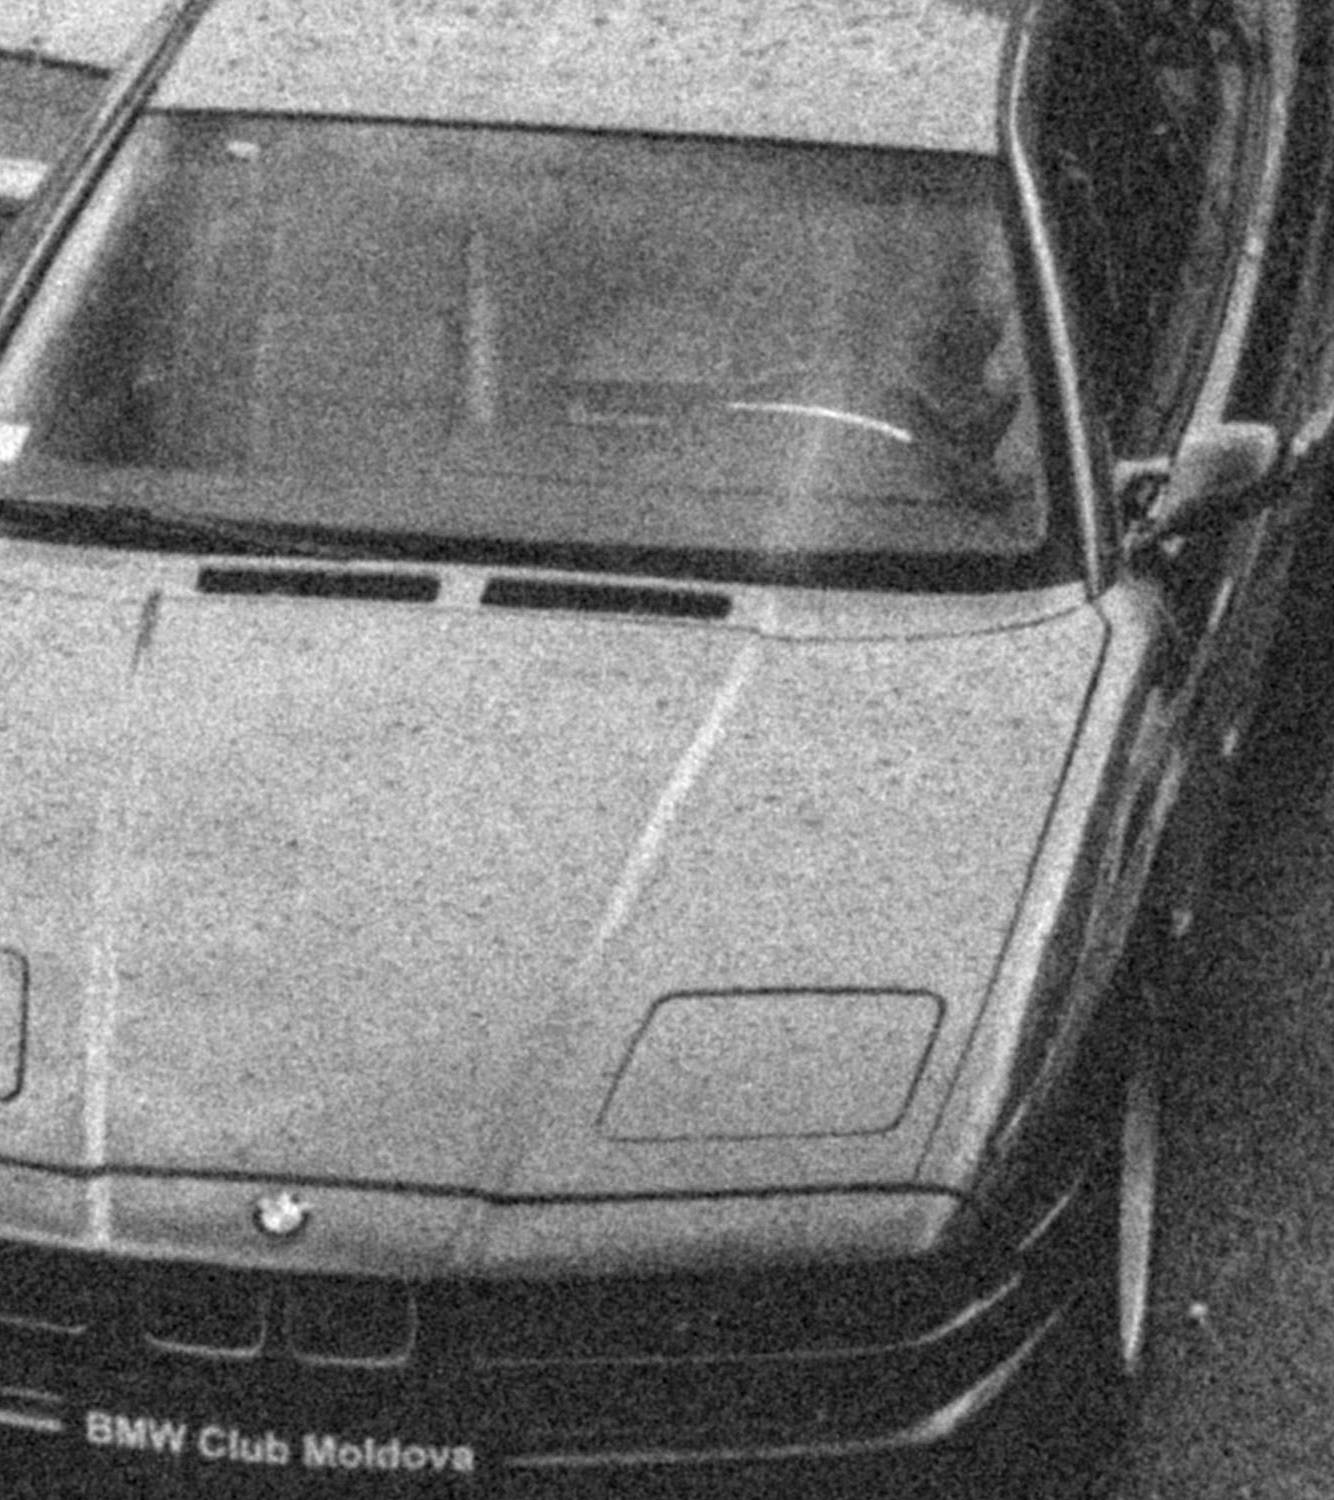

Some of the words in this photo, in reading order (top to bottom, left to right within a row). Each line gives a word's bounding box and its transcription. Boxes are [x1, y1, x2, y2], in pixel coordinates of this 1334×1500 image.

[86, 1410, 187, 1454] BMW
[198, 1424, 289, 1466] Club
[303, 1433, 474, 1471] Moldova
